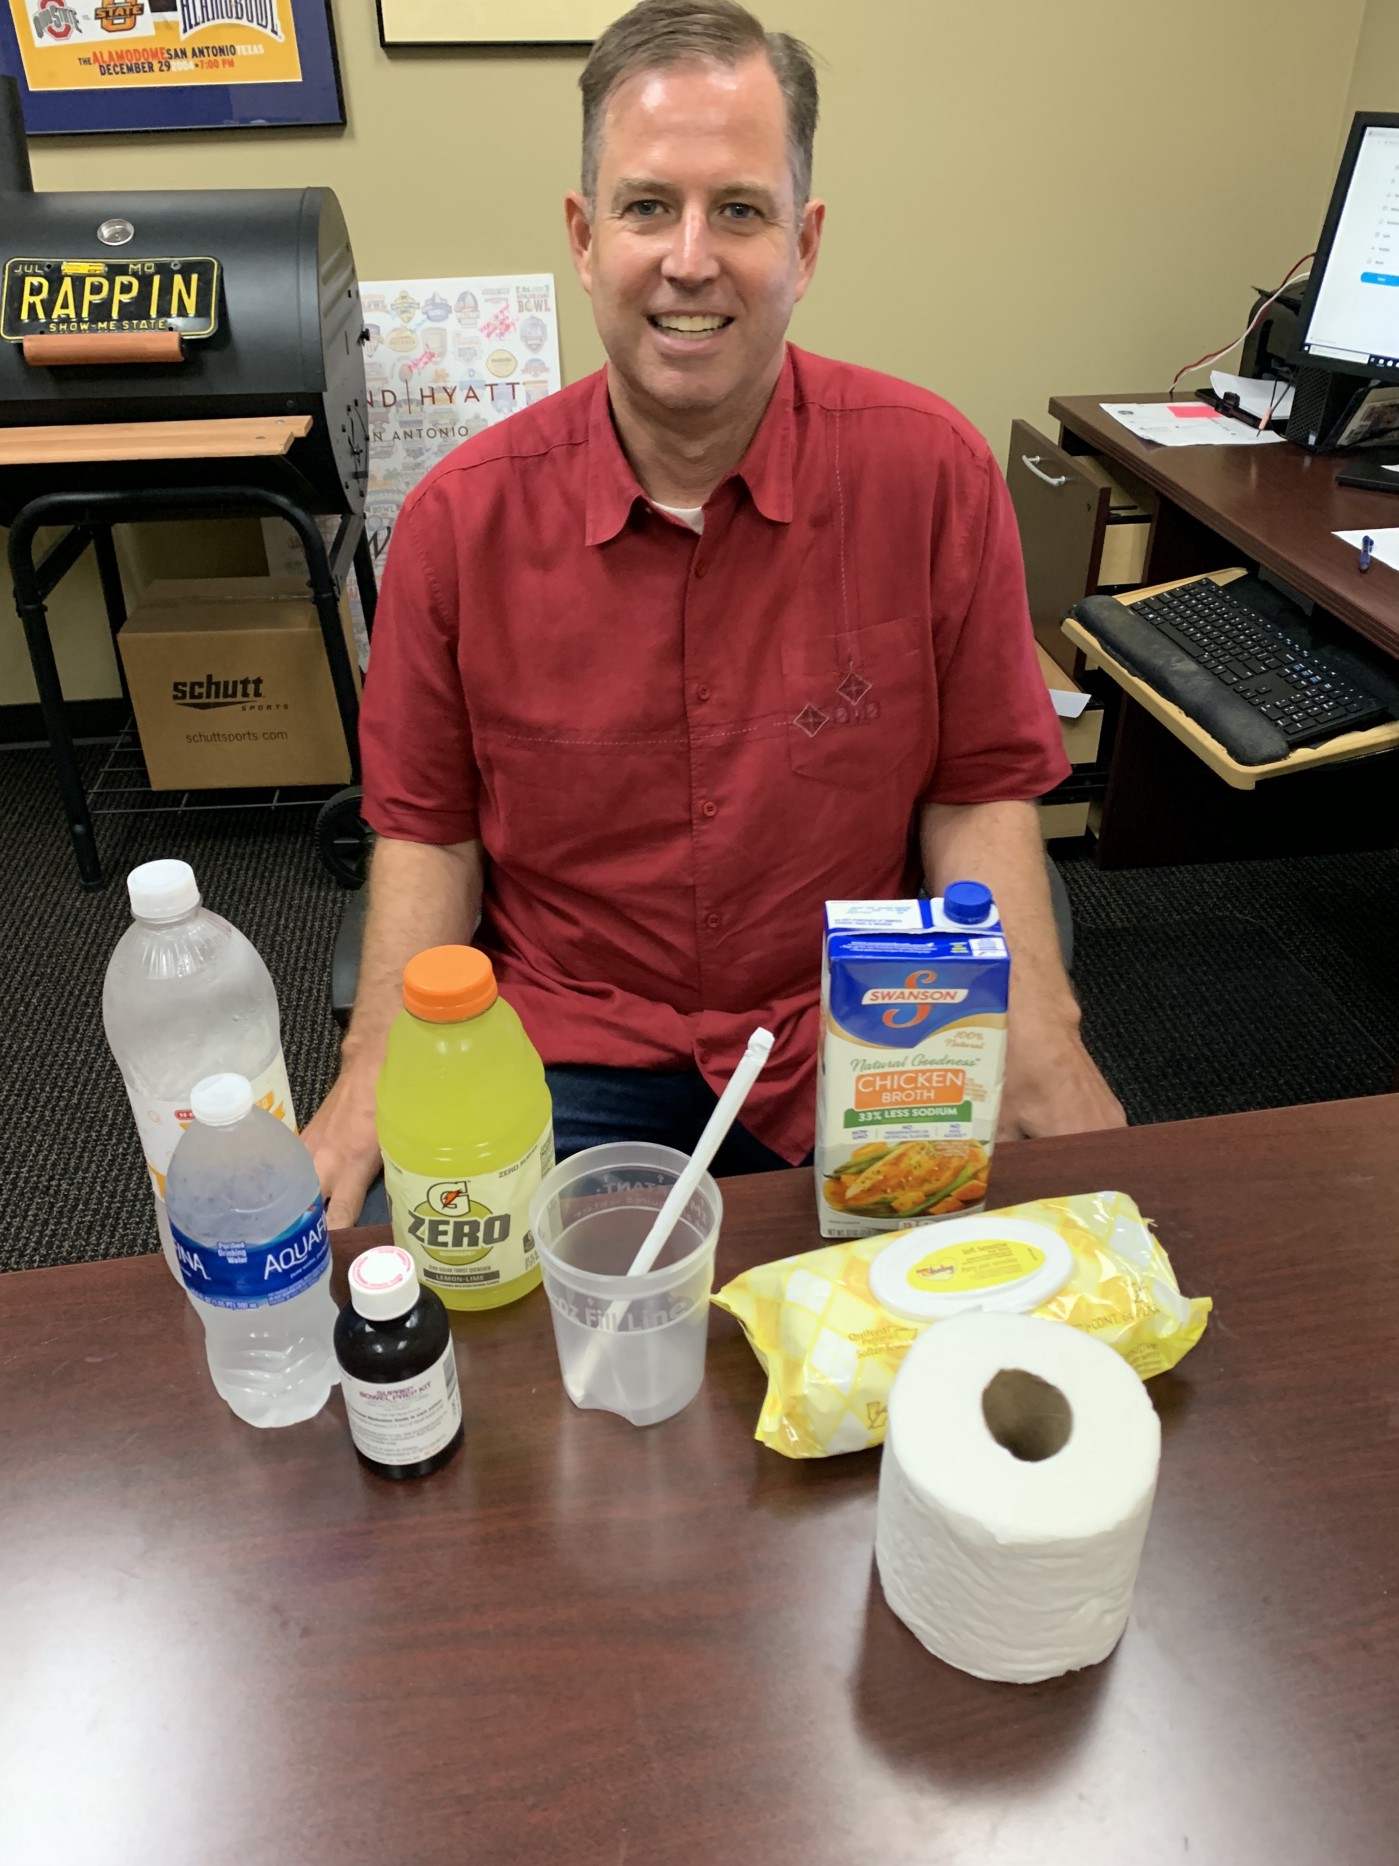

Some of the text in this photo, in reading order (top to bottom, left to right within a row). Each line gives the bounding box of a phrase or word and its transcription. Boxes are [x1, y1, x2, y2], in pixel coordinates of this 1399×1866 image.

[95, 3, 144, 20] STATE
[78, 44, 264, 66] THE ALAMODOME SAN ANTONIO TEXAS
[99, 61, 155, 76] DECEMBER
[158, 60, 171, 72] 29
[222, 58, 235, 68] PM
[14, 263, 155, 274] JUL MO
[20, 273, 199, 322] RAPPIN
[49, 319, 167, 332] SHOW-ME STATE
[419, 382, 521, 406] HYATT
[392, 425, 470, 441] ANTONIO
[172, 674, 263, 700] schutt
[241, 703, 289, 711] SPORTS
[186, 730, 288, 744] schuttsports.com
[868, 990, 958, 1002] SWANSON
[850, 1054, 977, 1073] Natural Goodness
[857, 1071, 964, 1093] CHICKEN
[881, 1089, 935, 1104] BROTH
[858, 1107, 959, 1122] 33% LESS SODIUM
[498, 1164, 519, 1178] ZERO
[427, 1181, 471, 1217] G
[408, 1209, 511, 1248] ZERO
[435, 1274, 485, 1283] LEMON-LIME
[584, 1307, 617, 1332] Fill
[628, 1301, 687, 1332] Line
